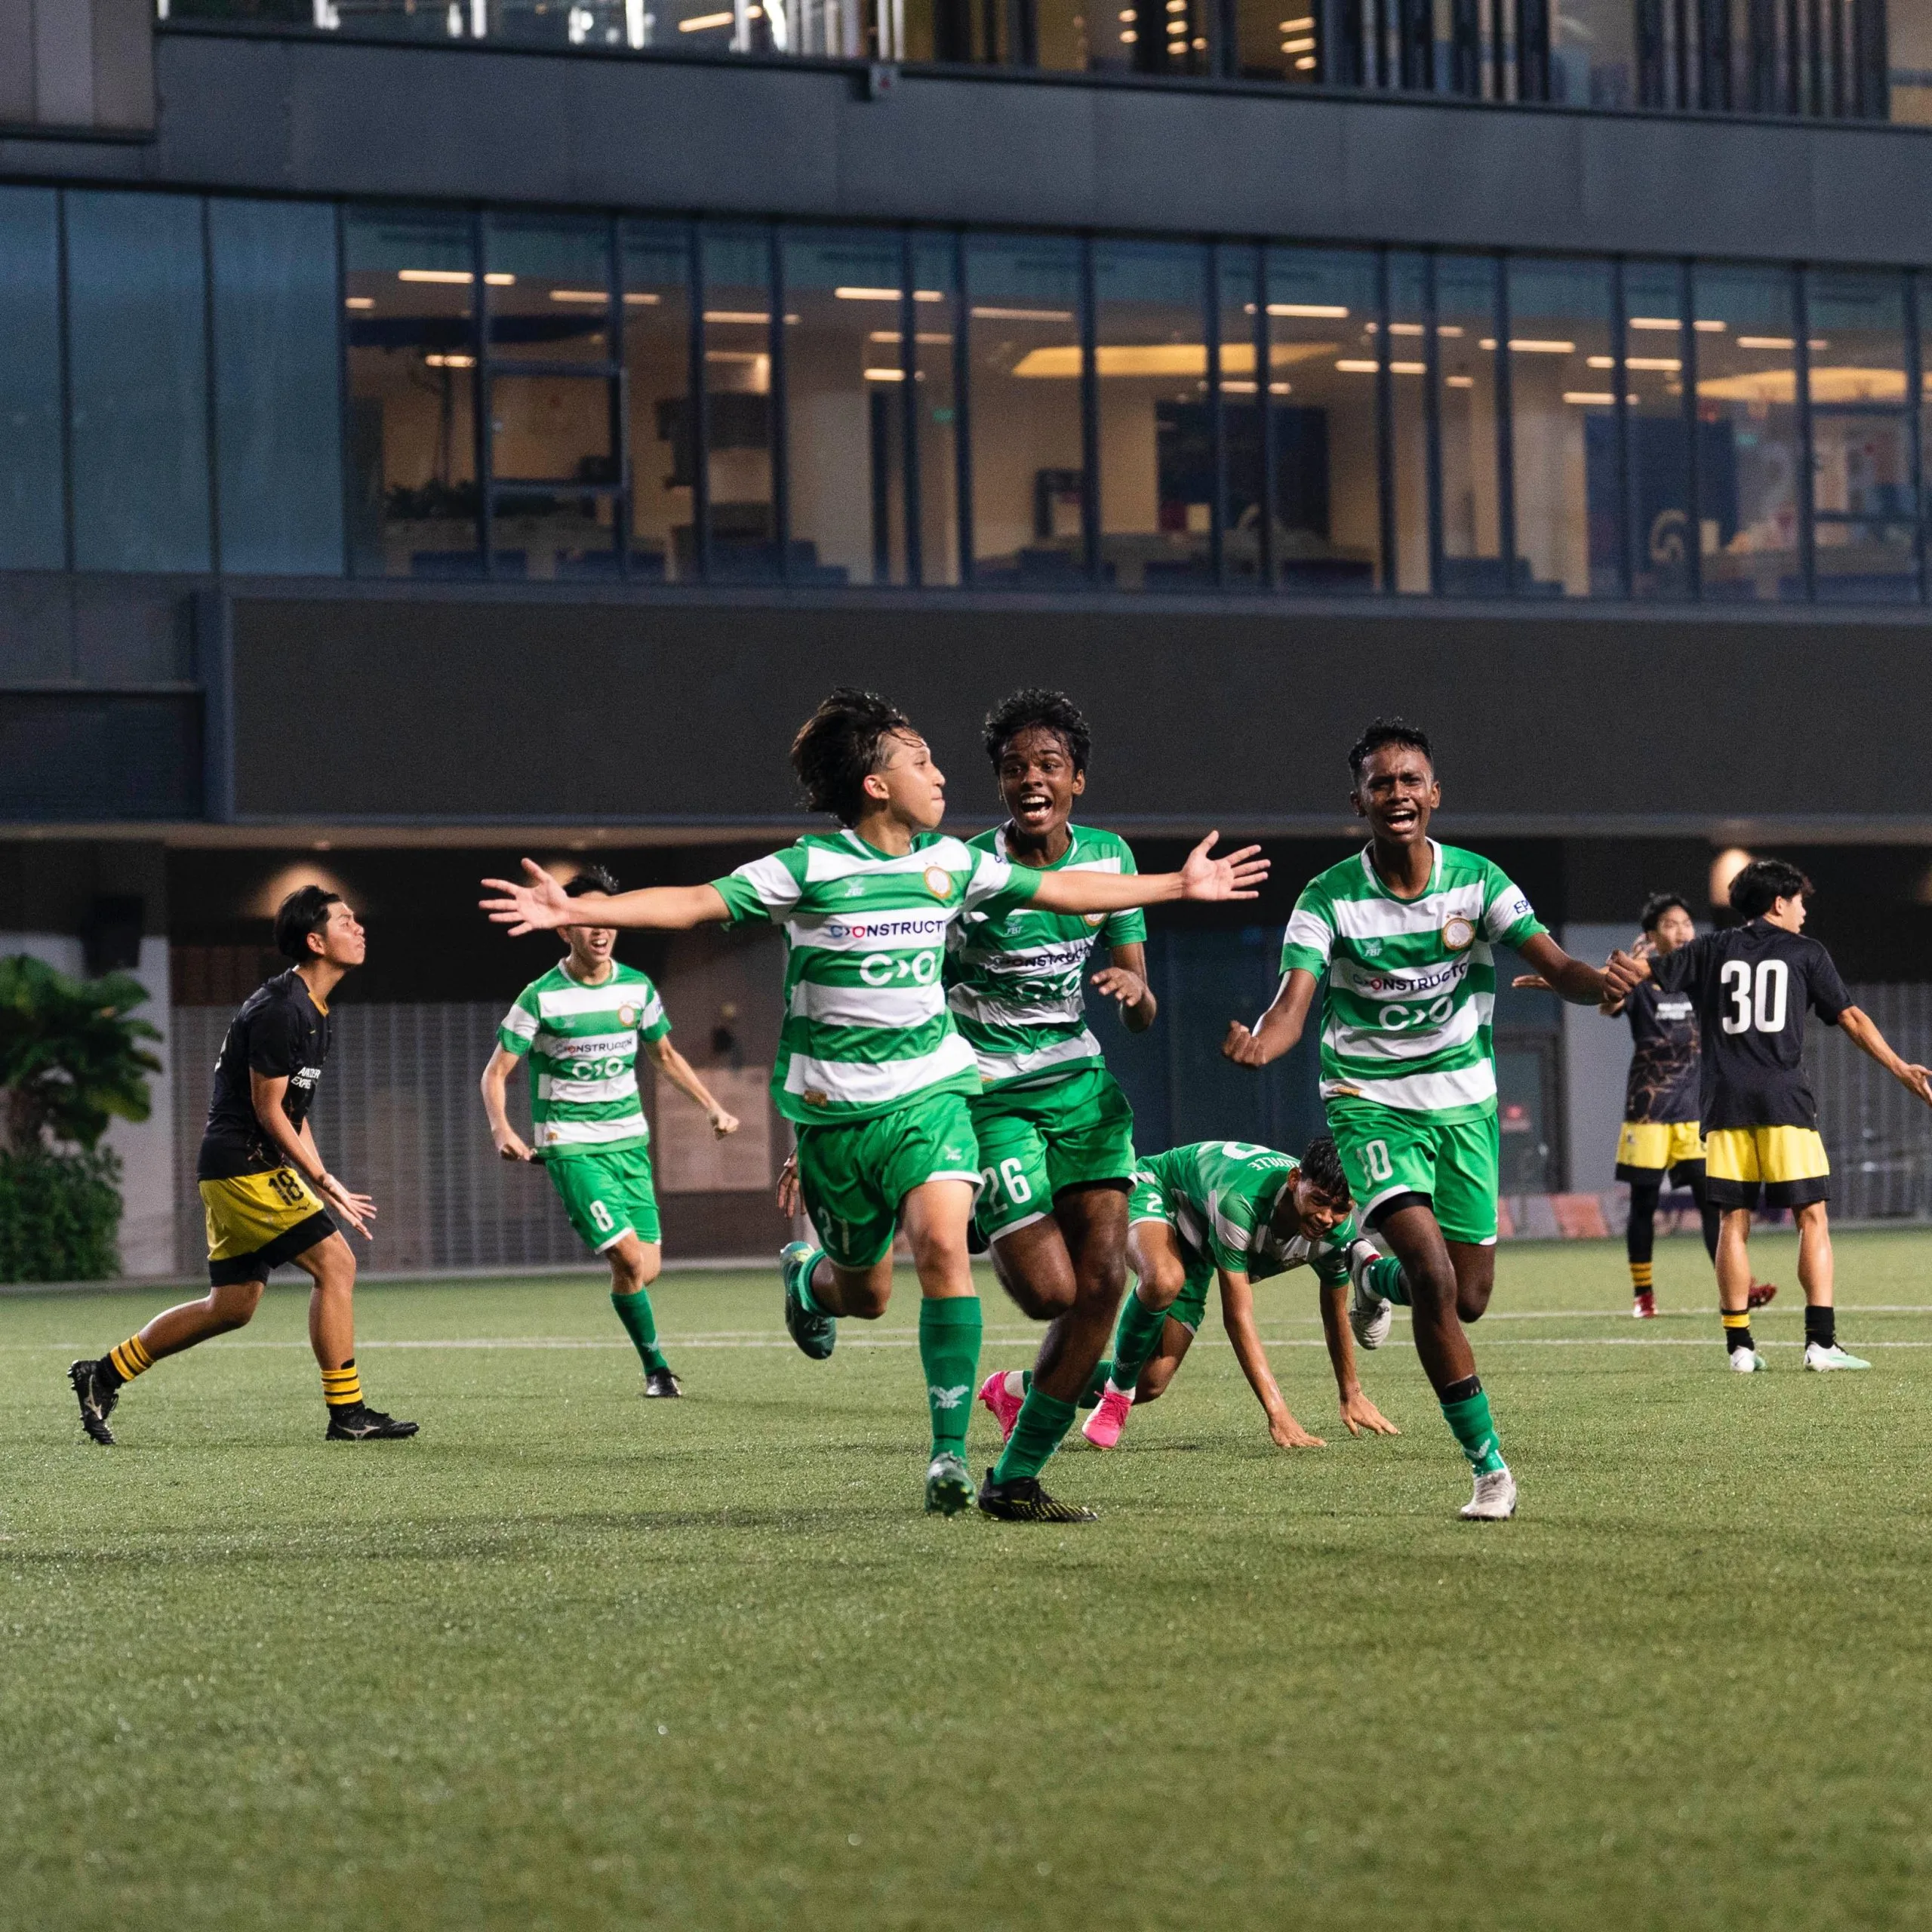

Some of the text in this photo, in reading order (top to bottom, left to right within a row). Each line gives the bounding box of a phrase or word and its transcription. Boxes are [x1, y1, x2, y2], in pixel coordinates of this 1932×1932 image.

[1364, 948, 1383, 957] FBT
[1721, 959, 1789, 1035] 30
[1356, 1139, 1394, 1190] 10
[268, 1171, 305, 1207] 18
[980, 1157, 1032, 1216] 26
[589, 1200, 615, 1232] 8
